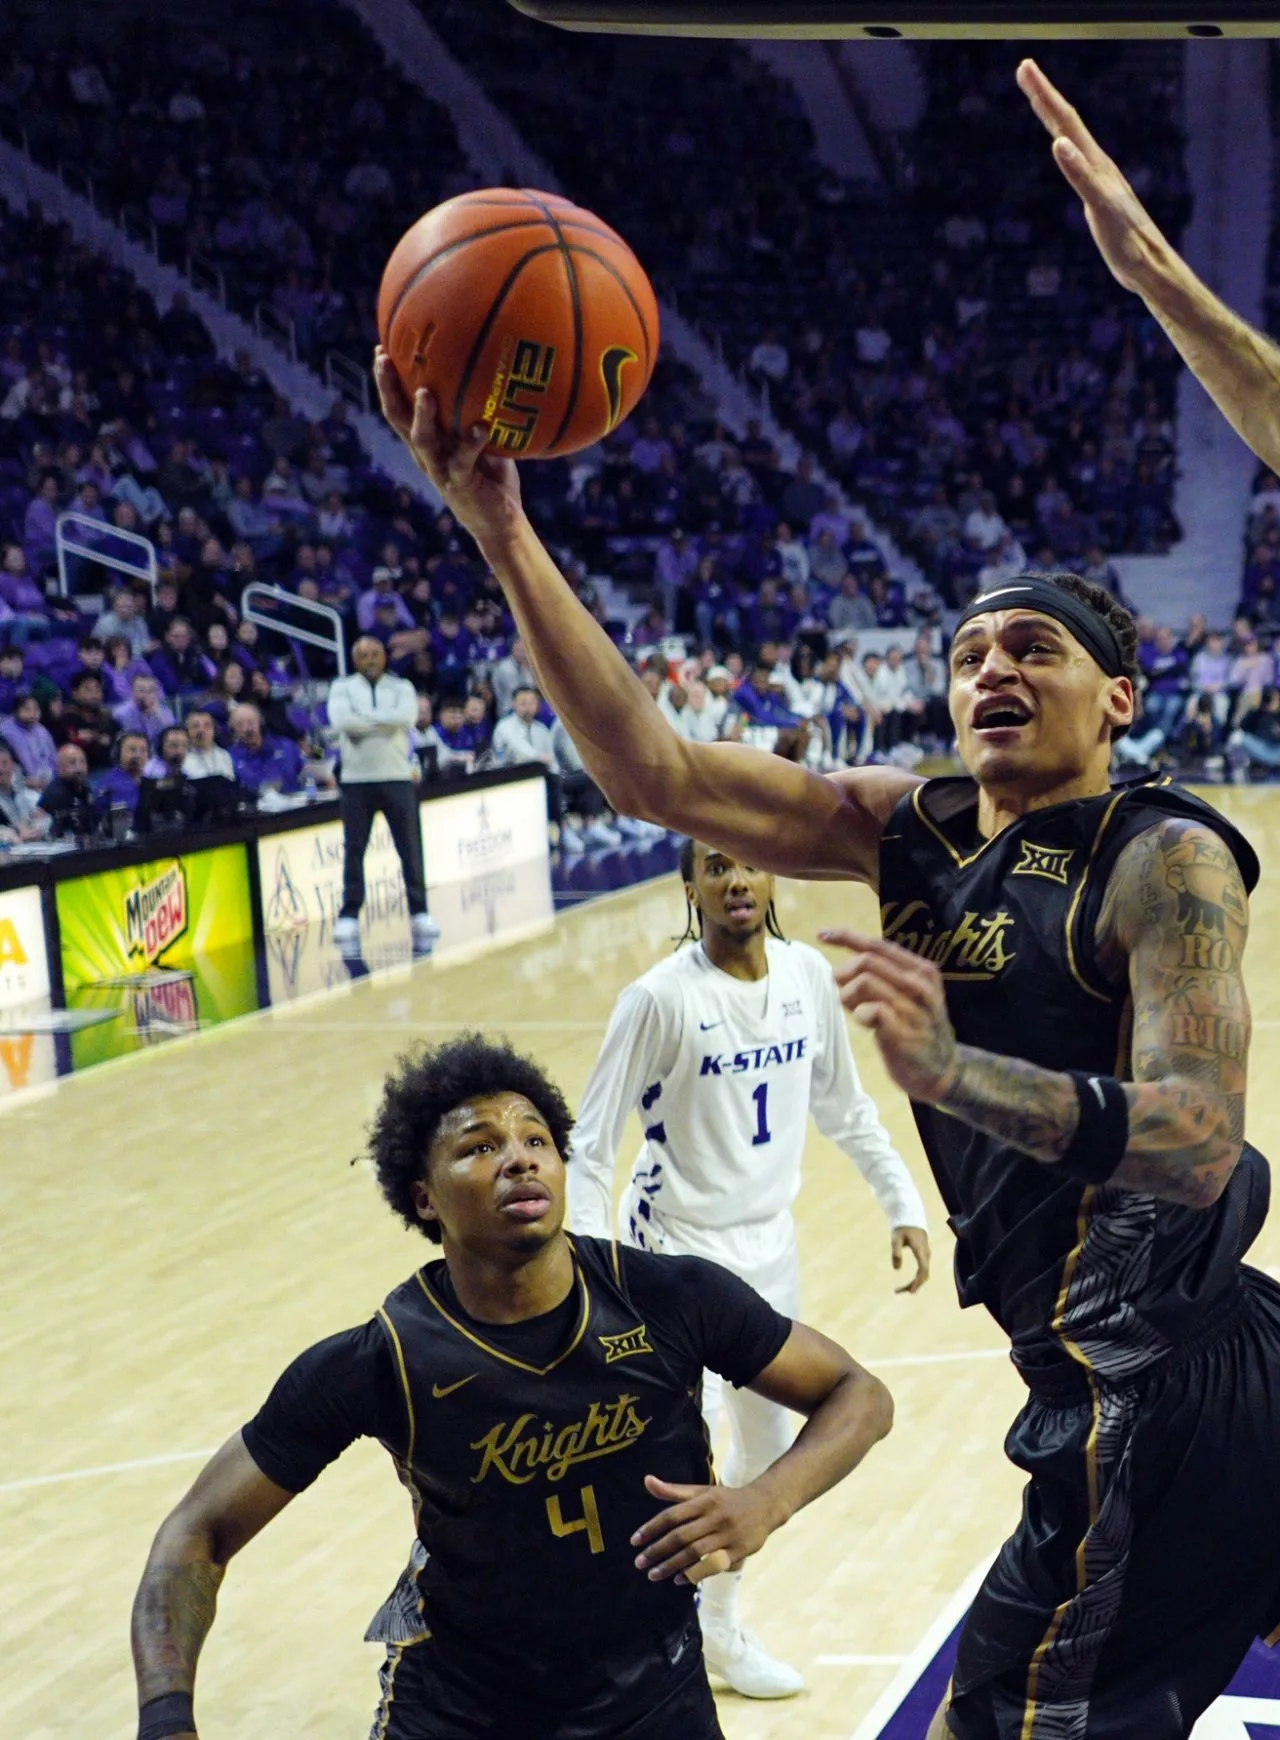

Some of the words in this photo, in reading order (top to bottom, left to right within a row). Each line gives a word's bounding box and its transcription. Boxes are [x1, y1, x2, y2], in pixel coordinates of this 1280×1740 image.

[699, 1036, 808, 1077] K-STATE
[752, 1082, 771, 1146] 1
[470, 1392, 653, 1484] Knights
[546, 1485, 605, 1554] 4
